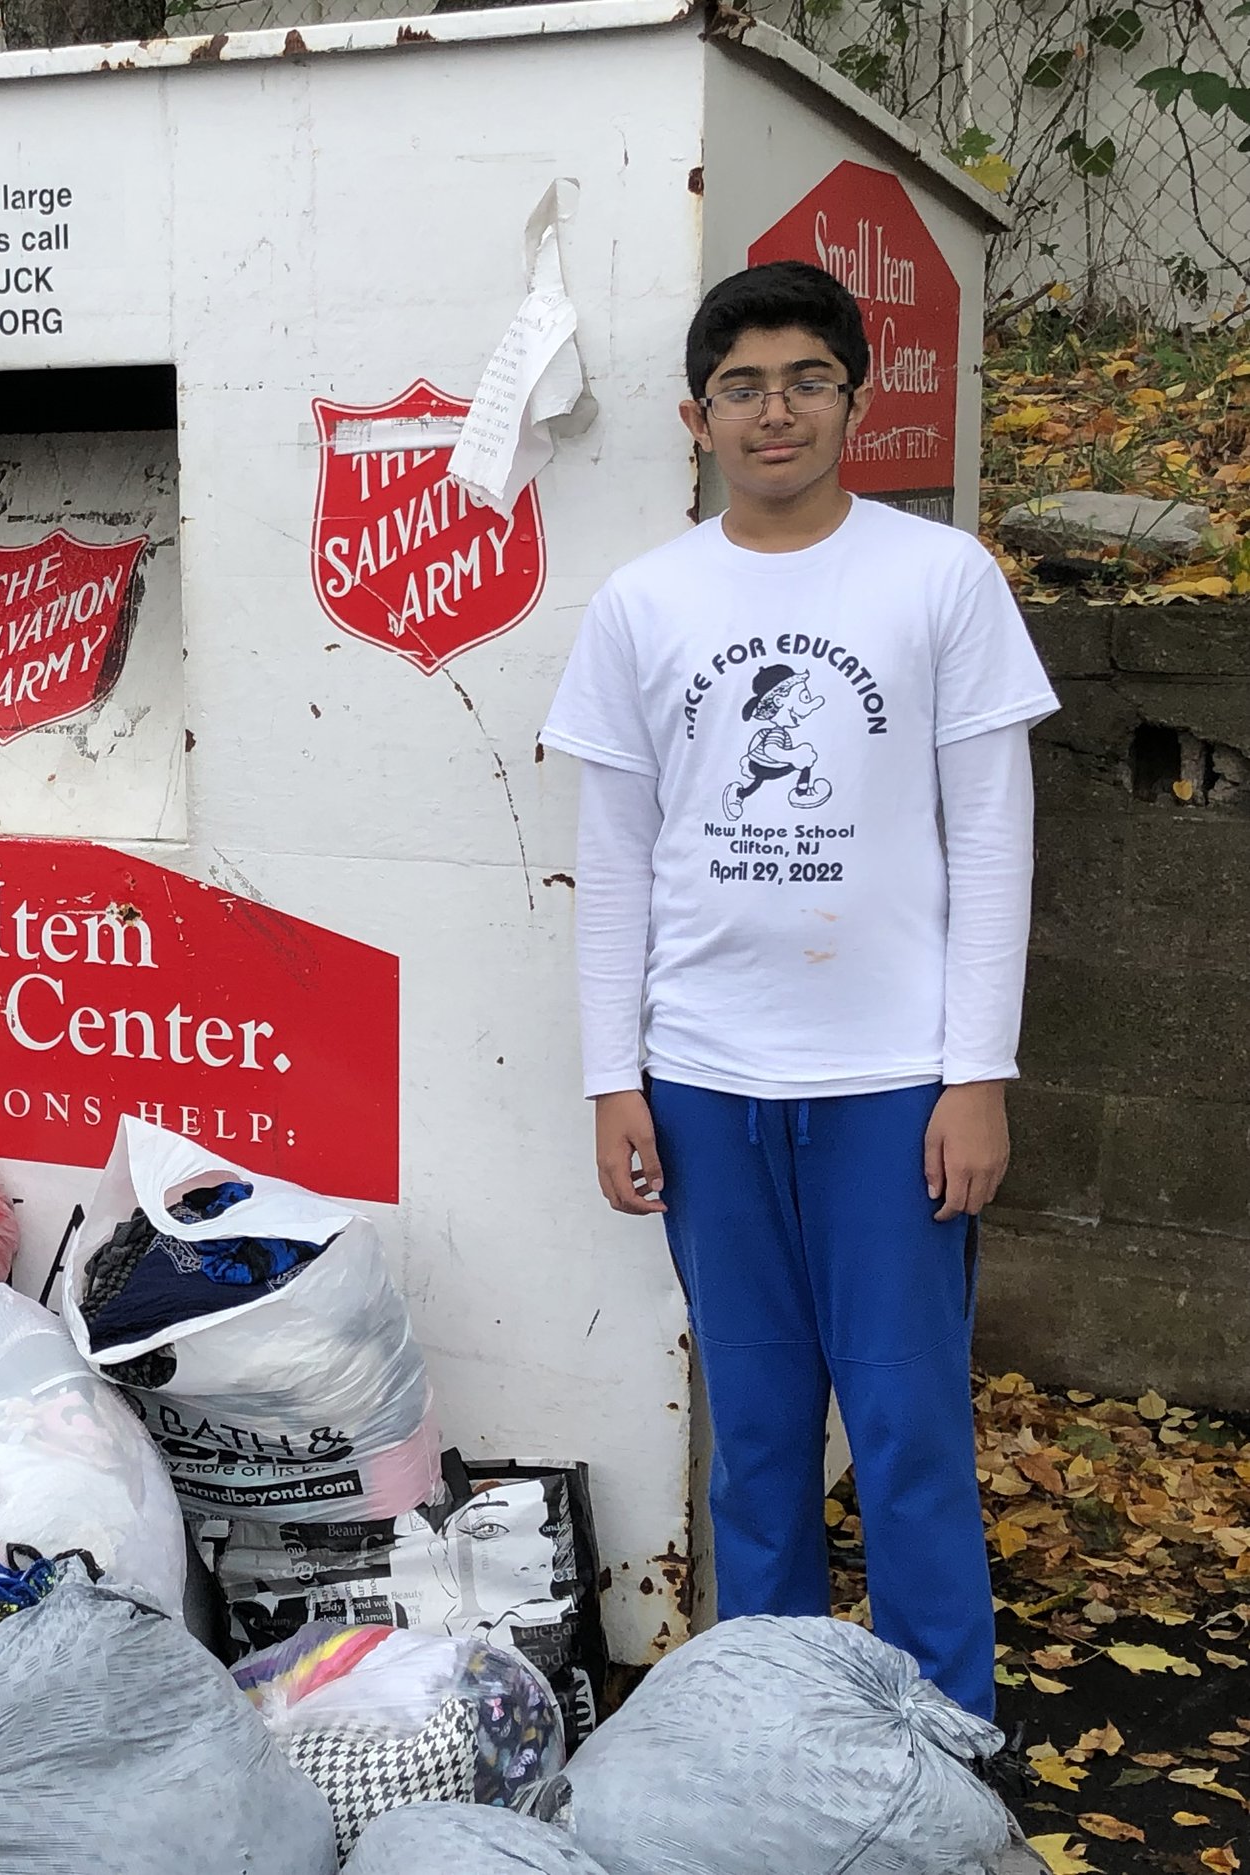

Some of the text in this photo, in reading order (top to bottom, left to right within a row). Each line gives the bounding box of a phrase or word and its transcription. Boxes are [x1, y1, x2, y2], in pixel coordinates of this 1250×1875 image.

[2, 184, 72, 215] large
[21, 223, 69, 251] call
[814, 211, 915, 305] Small Item
[880, 317, 939, 393] Center.
[840, 427, 901, 464] NATIONS
[325, 474, 486, 598] SALVATI
[395, 514, 514, 638] ARMY
[711, 637, 767, 675] FOR
[776, 633, 888, 735] EDUCATION
[704, 823, 855, 841] New Hope School
[730, 840, 820, 858] Clifton, NJ
[710, 859, 843, 885] April 29, 2022
[5, 973, 292, 1074] Center.
[137, 1100, 297, 1146] HELP:
[159, 1404, 295, 1457] BATH
[307, 1426, 355, 1454] &
[186, 1462, 236, 1476] store
[242, 1463, 265, 1477] of
